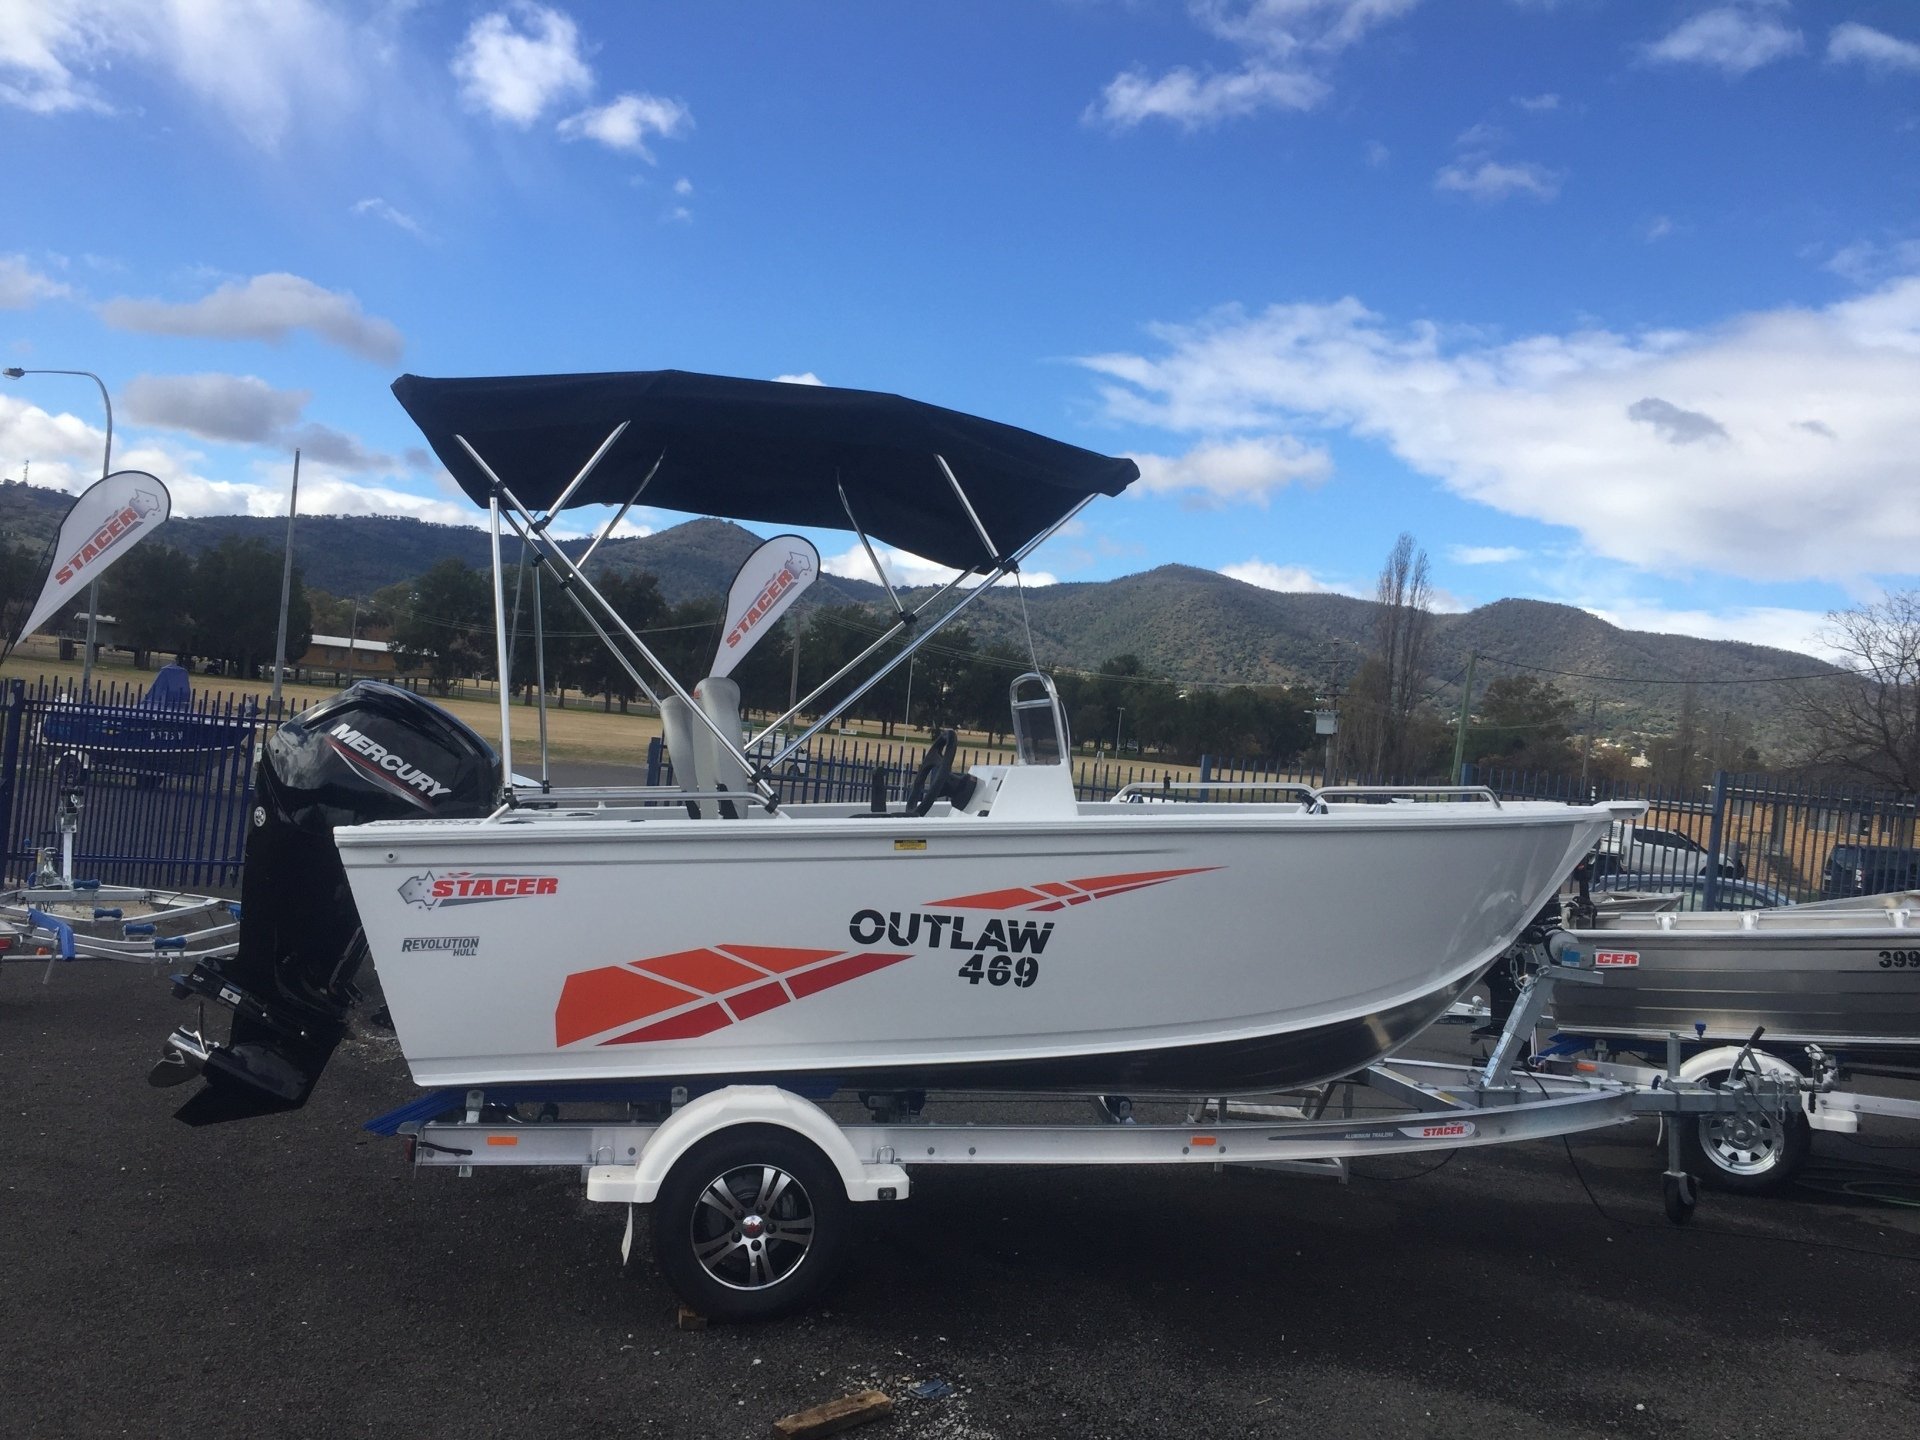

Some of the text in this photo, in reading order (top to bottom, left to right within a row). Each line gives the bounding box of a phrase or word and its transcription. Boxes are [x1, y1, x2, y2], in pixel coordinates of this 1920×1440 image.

[55, 506, 140, 585] STACER
[726, 569, 794, 648] STACER
[330, 723, 452, 798] MERCURY
[431, 877, 559, 898] STACER
[849, 909, 1055, 954] OUTLAW
[401, 937, 480, 953] REVOLUTION
[453, 949, 477, 957] HULL
[1597, 953, 1638, 964] CER
[1878, 950, 1920, 968] 399
[958, 954, 1039, 988] 469
[1423, 1126, 1464, 1137] STACER
